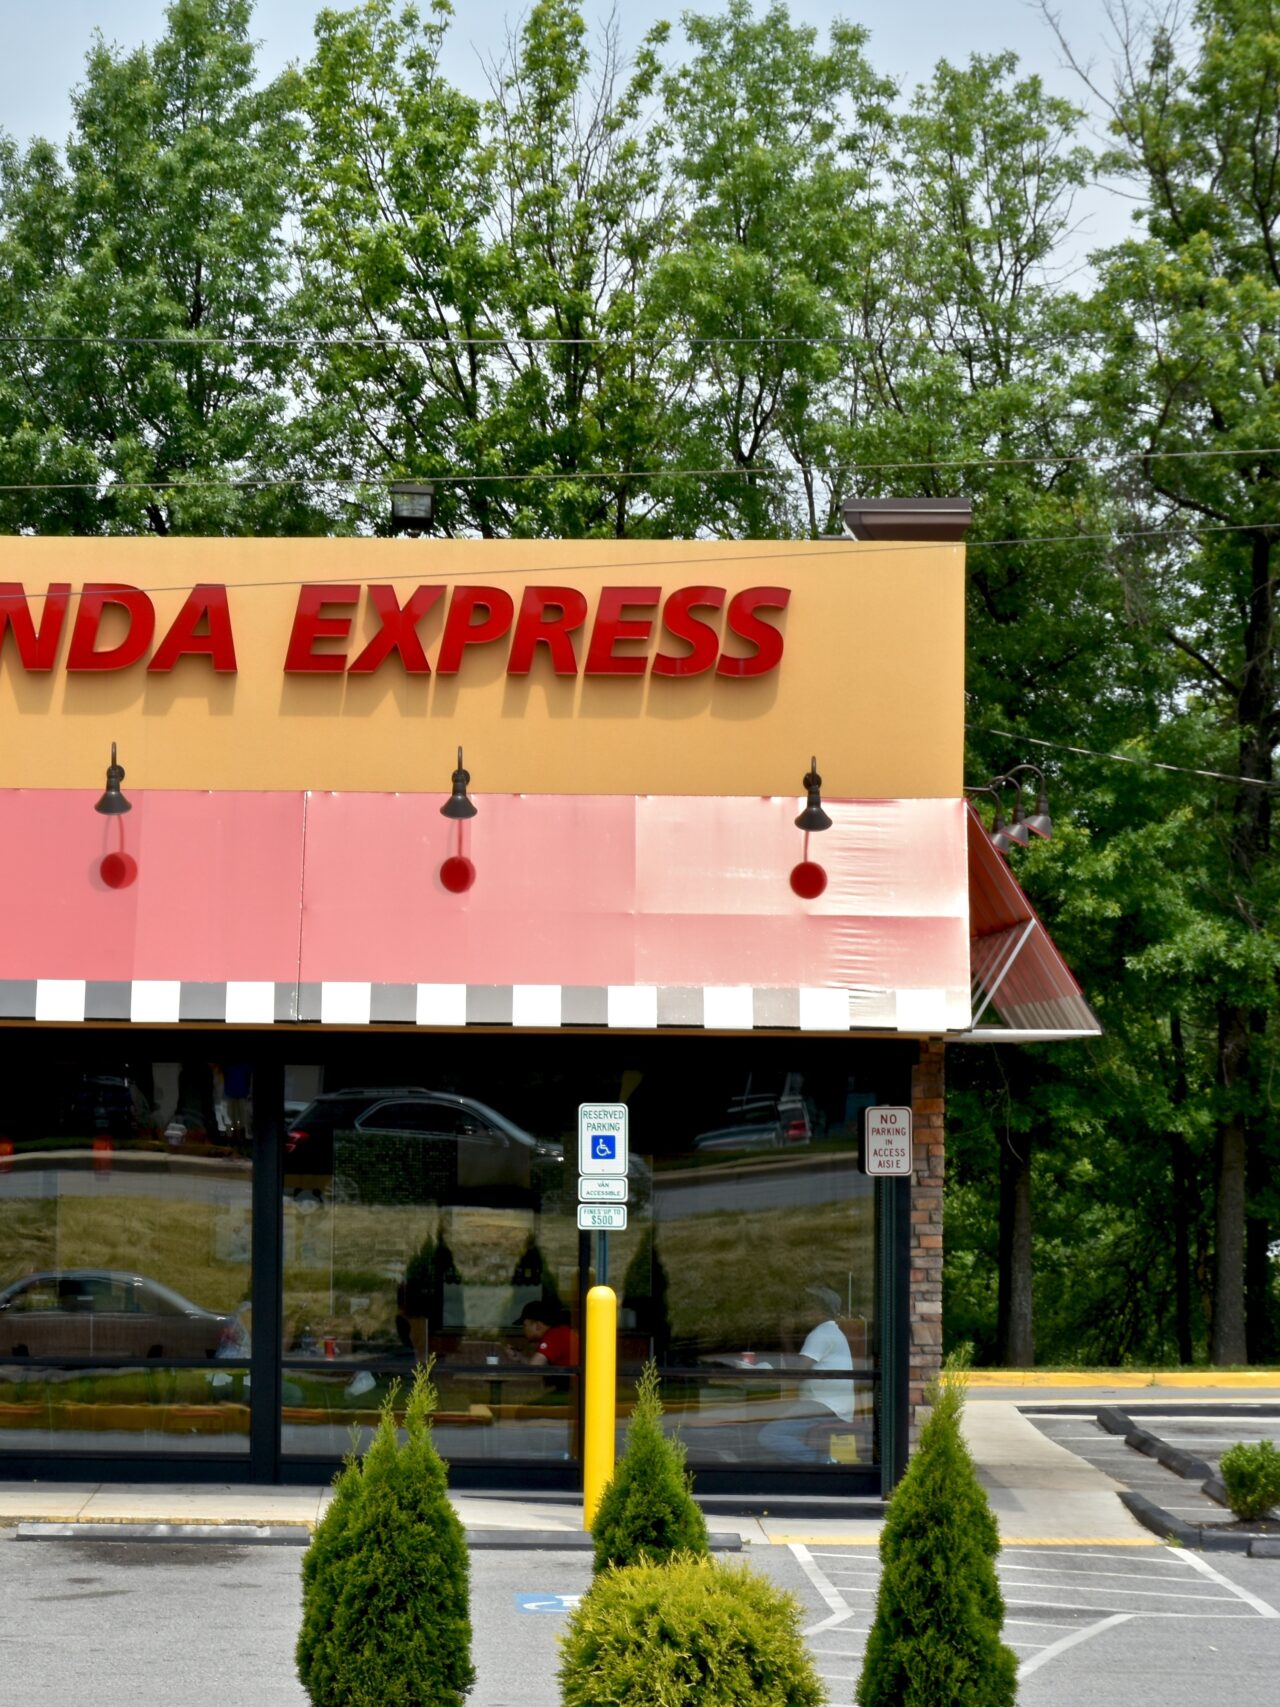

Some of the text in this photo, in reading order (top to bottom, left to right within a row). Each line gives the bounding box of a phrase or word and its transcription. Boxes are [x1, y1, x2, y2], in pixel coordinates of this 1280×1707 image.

[283, 584, 792, 677] EXPRESS
[583, 1110, 624, 1120] RESERVED
[880, 1114, 897, 1125] NO
[586, 1122, 620, 1131] PARKING
[871, 1127, 906, 1136] PARKING
[873, 1148, 906, 1157] ACCESS
[591, 1216, 613, 1225] $500
